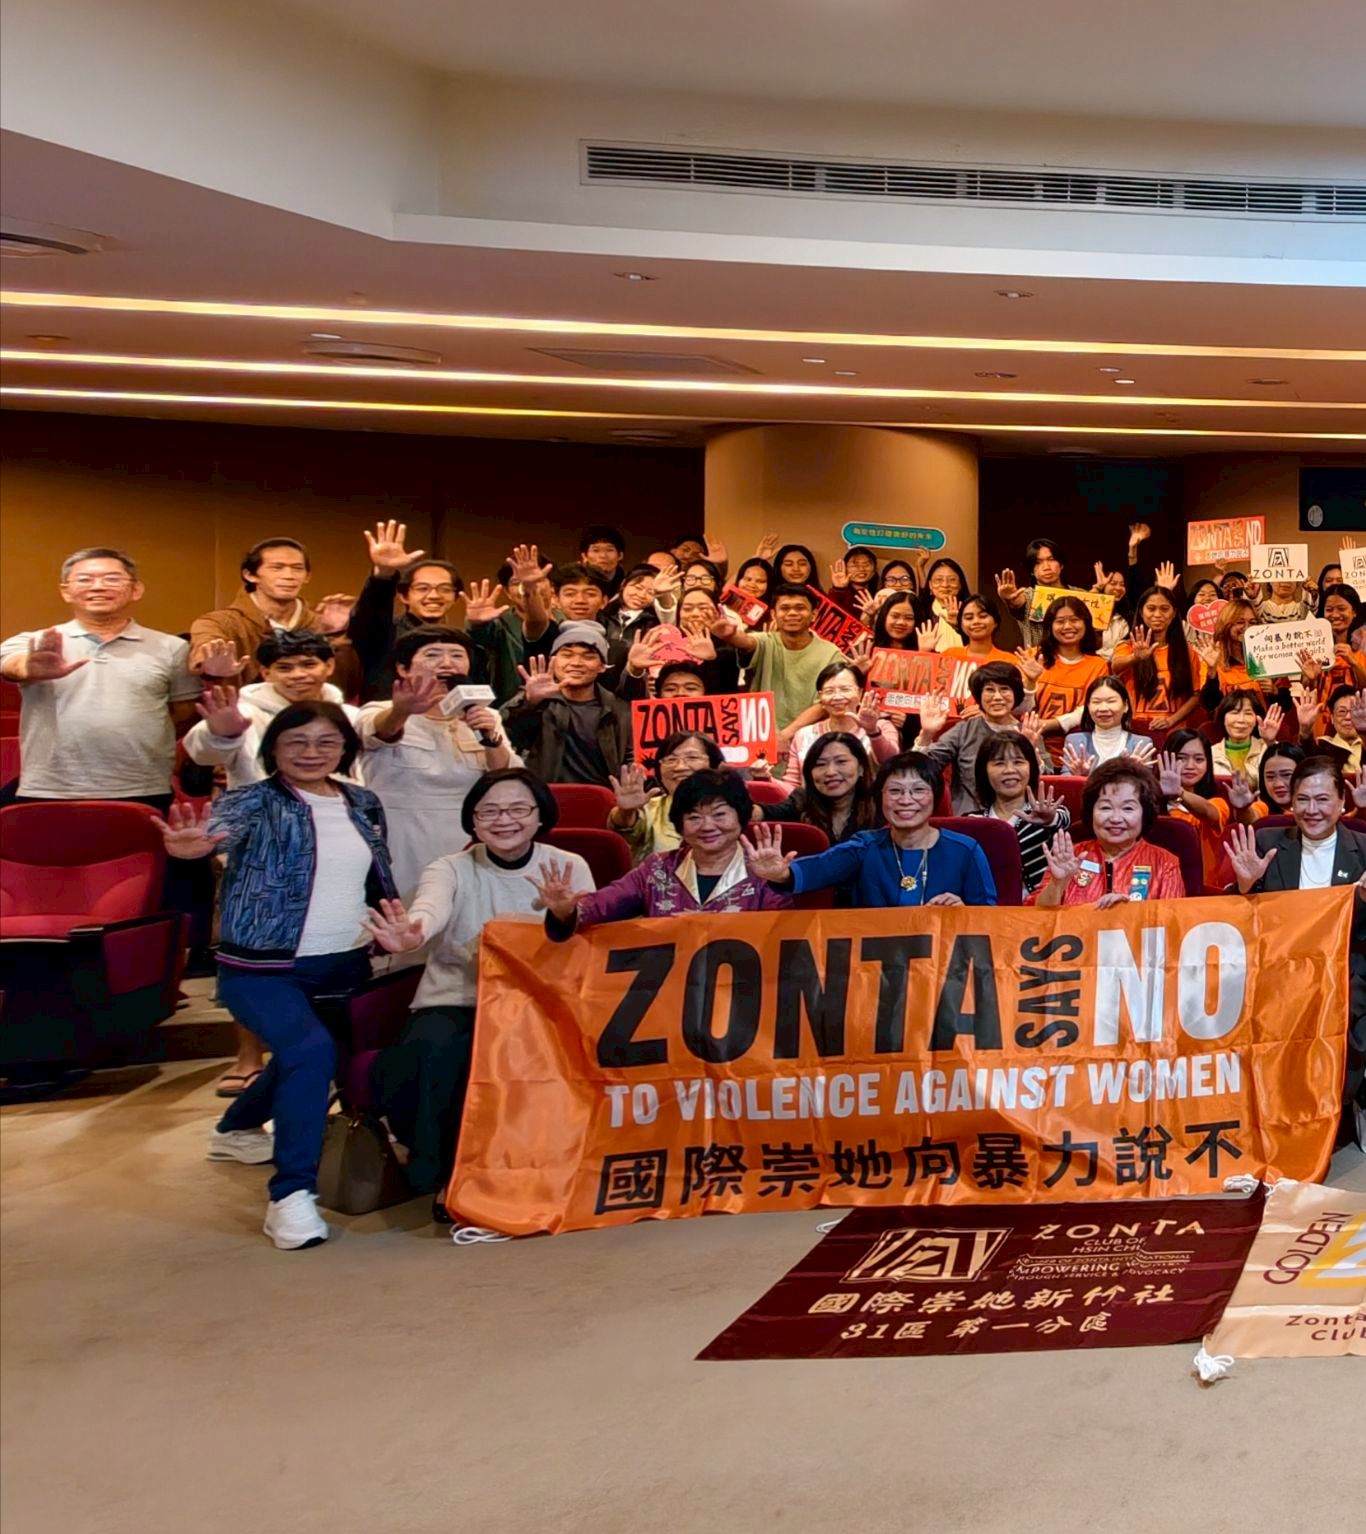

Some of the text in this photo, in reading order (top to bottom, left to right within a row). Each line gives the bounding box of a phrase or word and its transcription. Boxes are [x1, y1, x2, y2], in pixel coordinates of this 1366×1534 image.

[1190, 523, 1232, 550] ZONTA
[1246, 520, 1262, 546] NO
[1252, 568, 1305, 579] ZONTA
[871, 650, 932, 693] ZONTA
[637, 696, 771, 749] ZONTA SAYS NO
[597, 921, 1247, 1068] ZONTA SAYS NO
[605, 1052, 1241, 1128] TO VIOLENCE AGAINST WOMEN
[594, 1119, 1243, 1216] 國際崇她向暴力說不
[1032, 1219, 1205, 1241] ZONTA
[1083, 1238, 1122, 1246] CLUB
[1071, 1246, 1110, 1254] HSIN
[1263, 1211, 1353, 1285] GOLDEN
[807, 1284, 1175, 1315] 國際崇她新竹社
[840, 1311, 1112, 1340] 31區 第一分區
